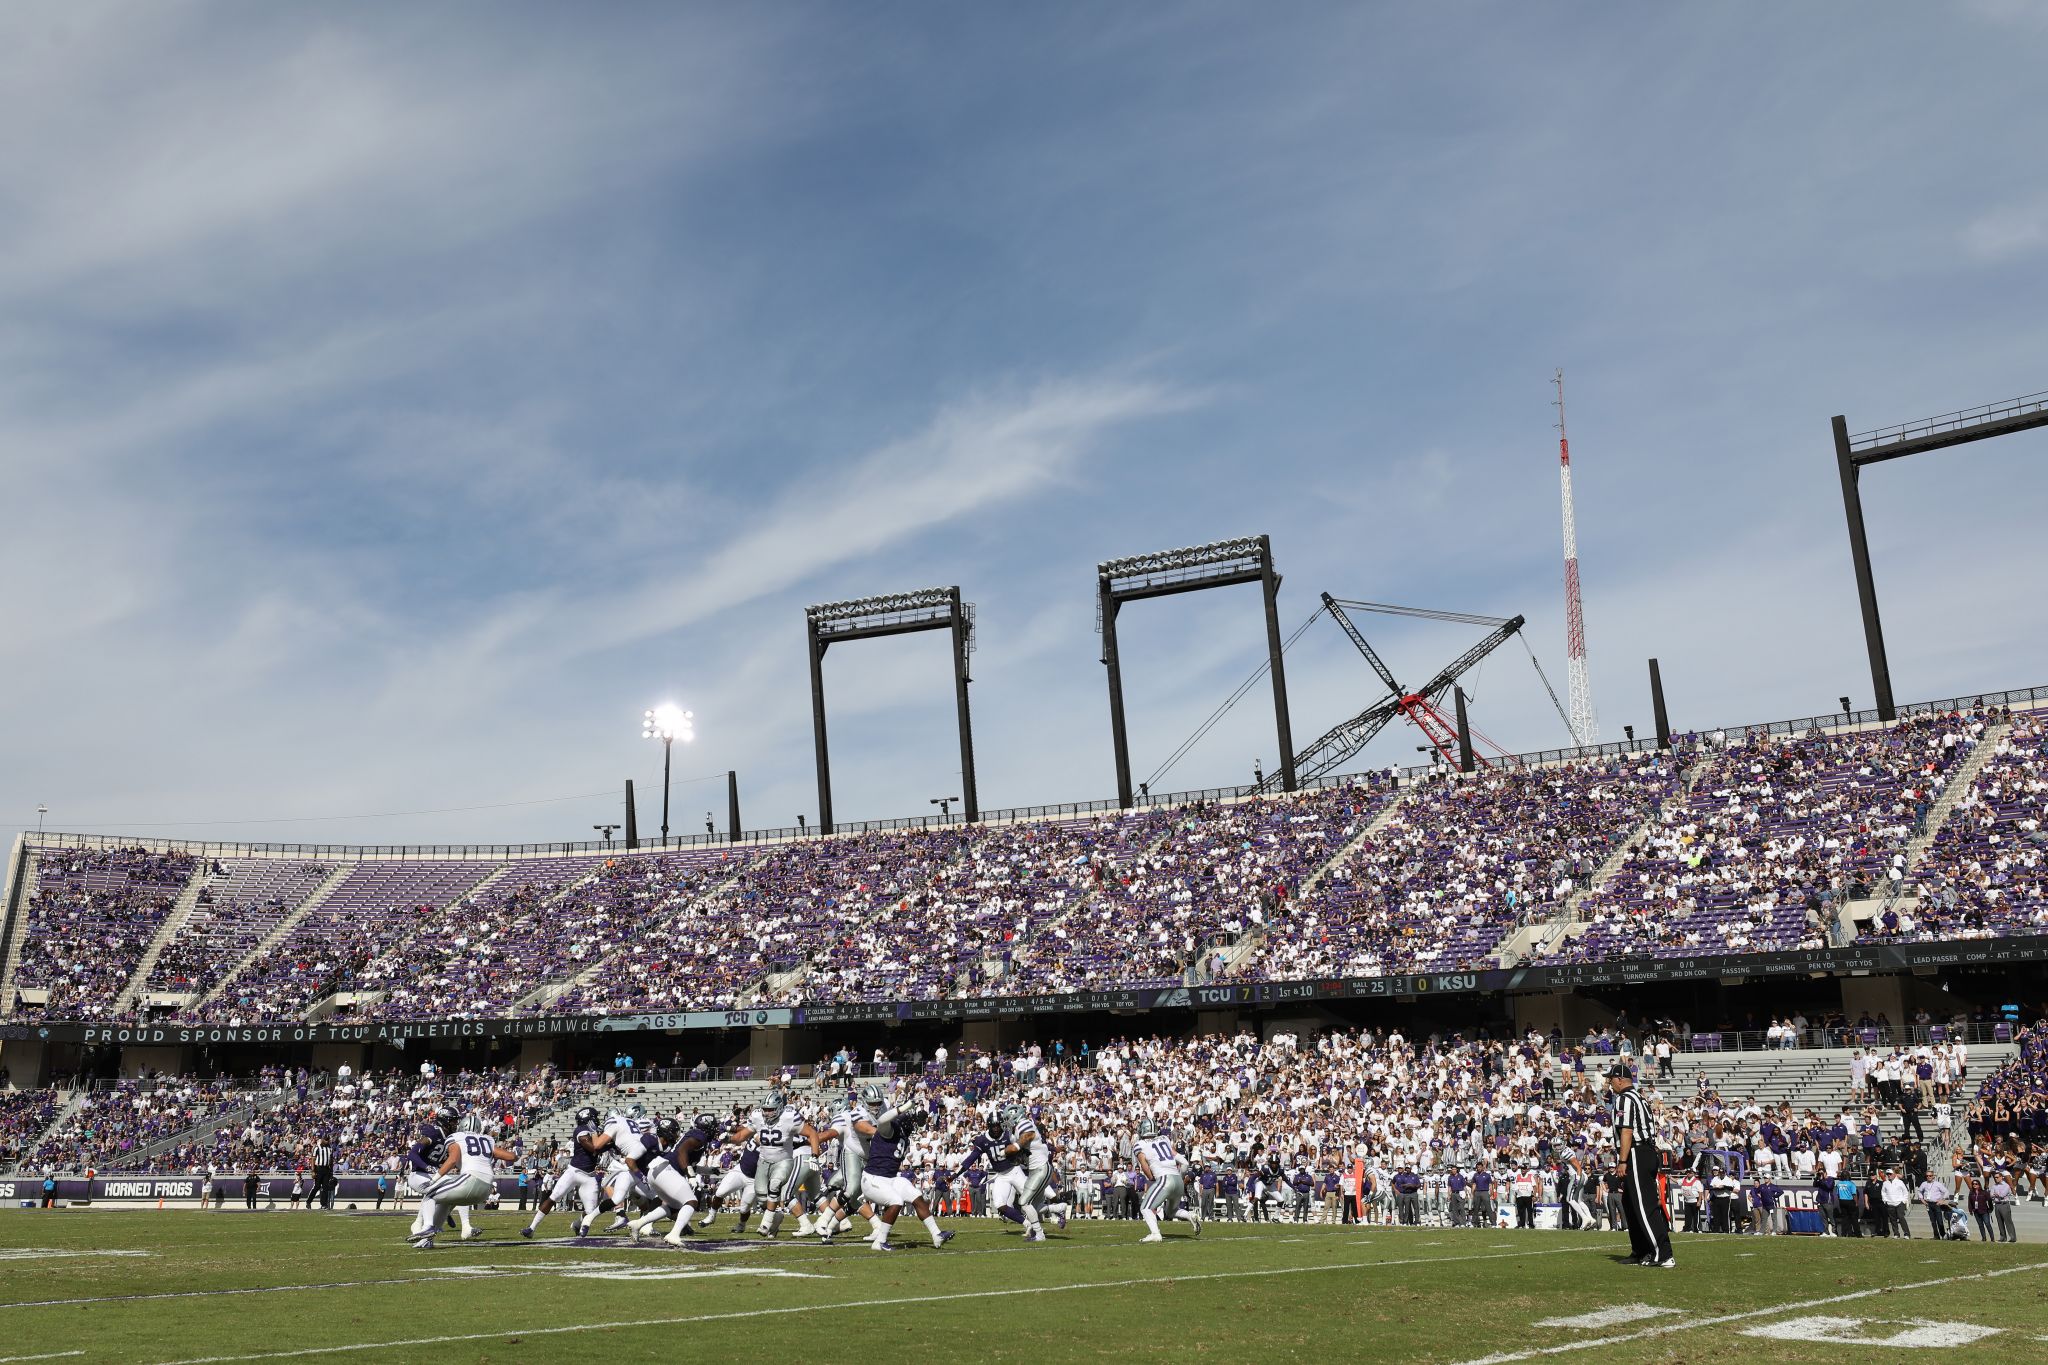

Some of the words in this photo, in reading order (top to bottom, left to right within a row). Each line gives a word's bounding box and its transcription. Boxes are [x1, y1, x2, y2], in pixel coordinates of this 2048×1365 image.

[1932, 954, 1958, 963] PASSER
[1765, 964, 1796, 972] RUSHING
[1371, 981, 1384, 992] 25
[1418, 979, 1427, 990] 0
[1439, 975, 1476, 990] KSU
[1199, 988, 1231, 1002] TCU
[1242, 988, 1250, 1000] 7
[1279, 987, 1291, 997] 1ST
[1300, 986, 1313, 996] 10
[725, 1011, 750, 1025] TCU
[84, 1030, 164, 1041] PROUD
[180, 1029, 281, 1041] SPONSOR
[294, 1028, 317, 1040] OF
[379, 1022, 484, 1038] ATHLETICS
[760, 1129, 783, 1146] 62
[465, 1136, 494, 1158] 80
[989, 1145, 1006, 1162] 15
[1152, 1141, 1174, 1162] 10
[104, 1182, 150, 1196] HORNED
[154, 1182, 192, 1196] FROGS
[1428, 1180, 1436, 1188] 12
[1543, 1178, 1553, 1186] 14
